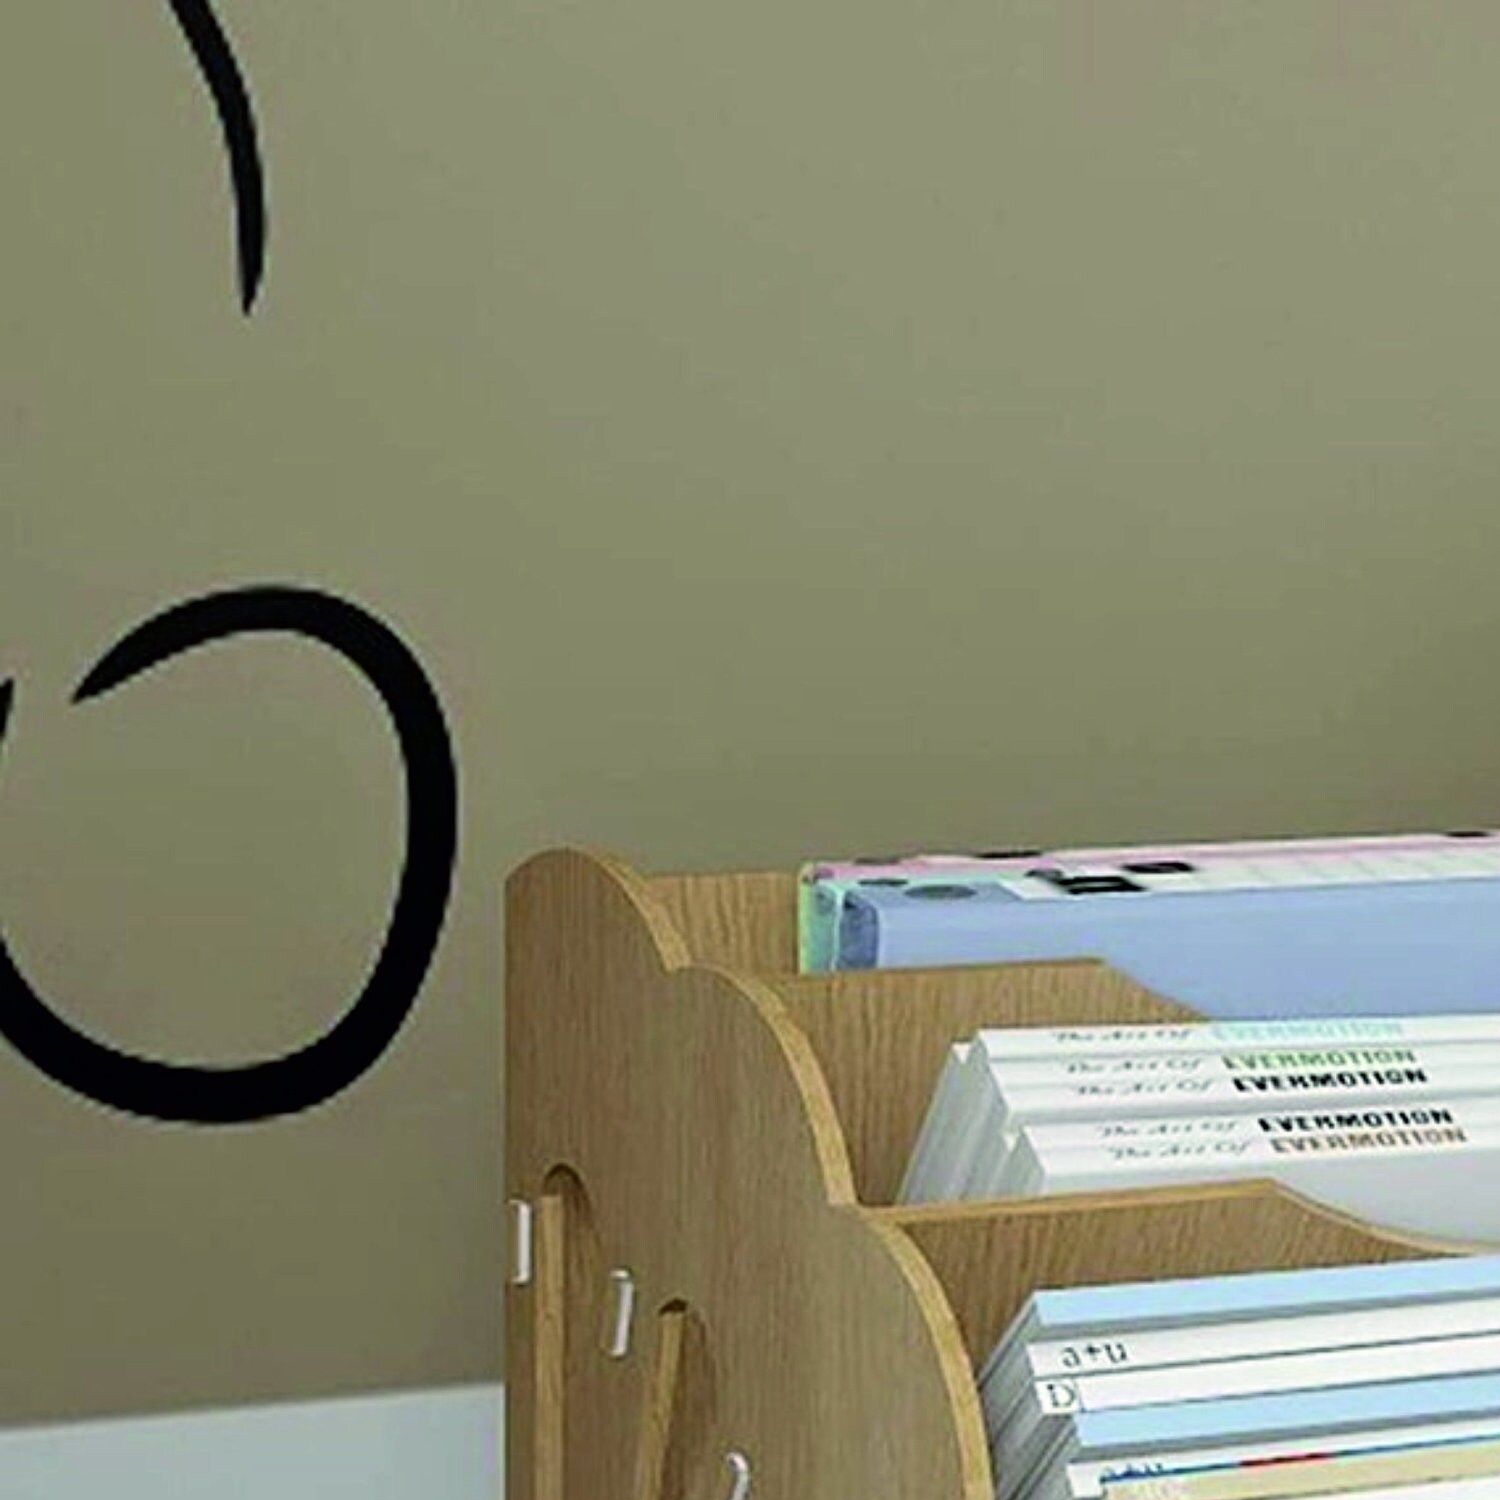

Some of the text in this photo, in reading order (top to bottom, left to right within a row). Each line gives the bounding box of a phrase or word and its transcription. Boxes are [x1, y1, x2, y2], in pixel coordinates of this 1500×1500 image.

[1221, 1049, 1417, 1070] EVERMOTION
[1232, 1068, 1428, 1092] EVERMOTION
[1258, 1108, 1454, 1132] EVERMOTION
[1270, 1128, 1468, 1153] EVERMOTION
[1062, 1343, 1128, 1367] a+u
